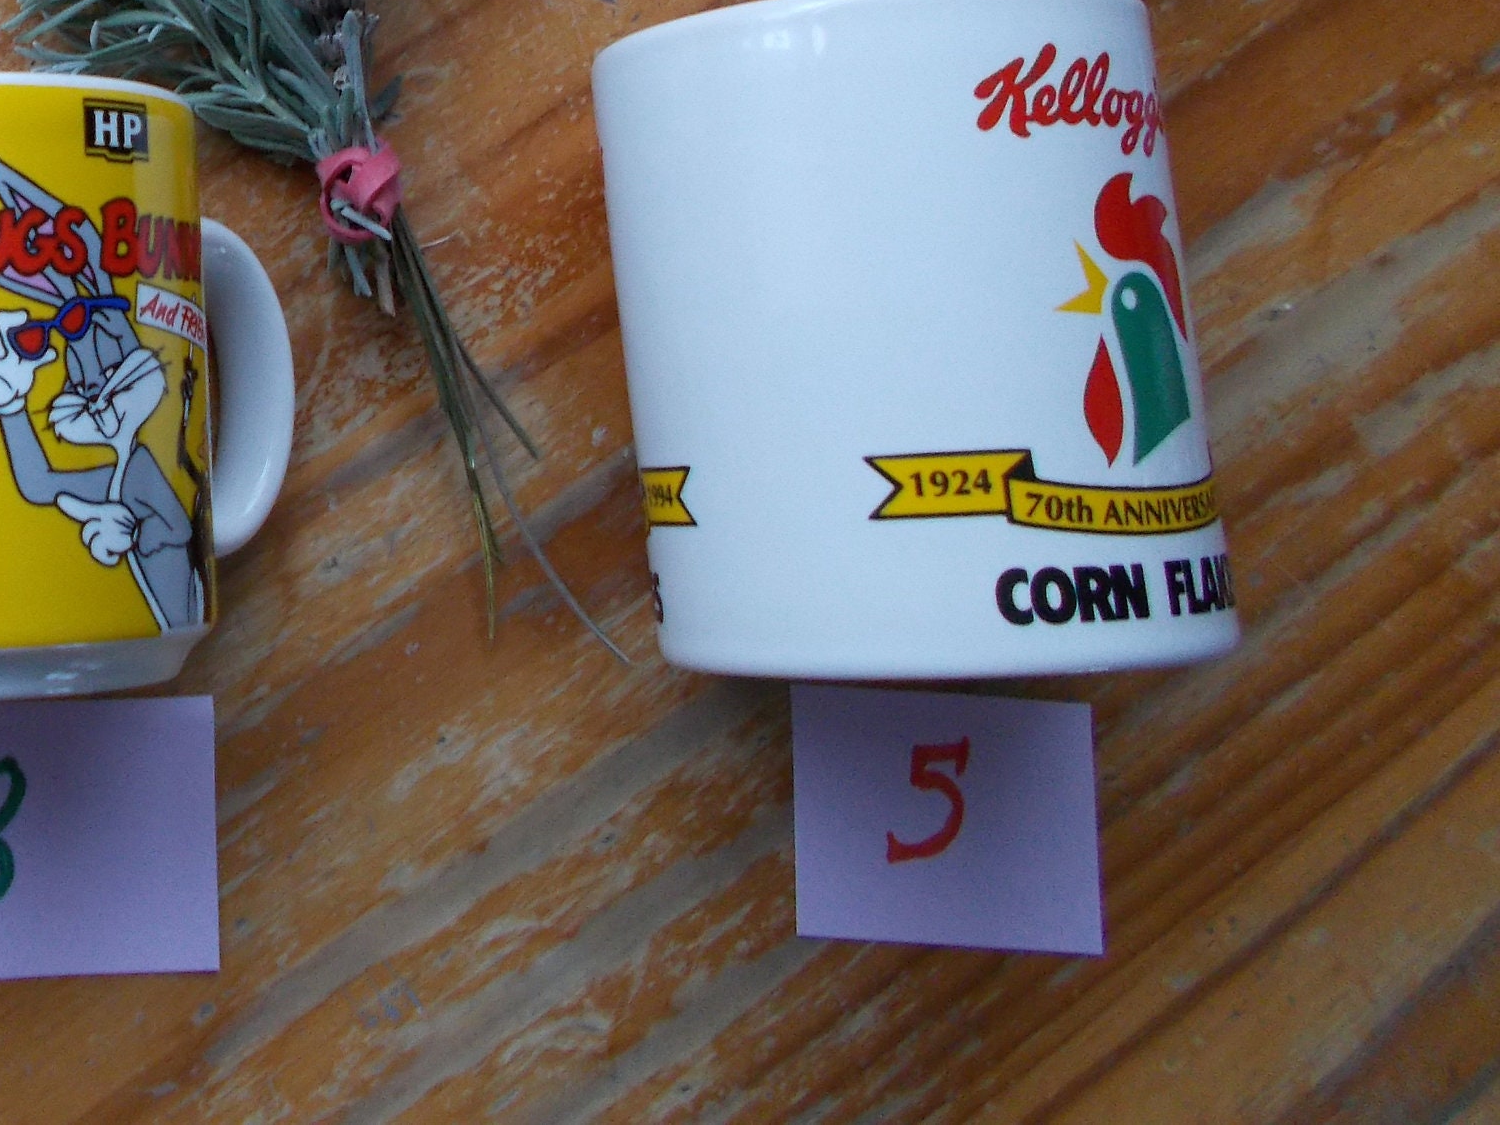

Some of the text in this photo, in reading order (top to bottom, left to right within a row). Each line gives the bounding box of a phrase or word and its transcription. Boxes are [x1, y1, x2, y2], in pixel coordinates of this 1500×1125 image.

[974, 43, 1163, 157] Kellogg
[93, 109, 142, 149] HP
[140, 292, 180, 327] And
[910, 469, 992, 497] 1924
[1025, 491, 1094, 524] 70th
[995, 562, 1150, 626] CORN
[886, 735, 970, 864] 5
